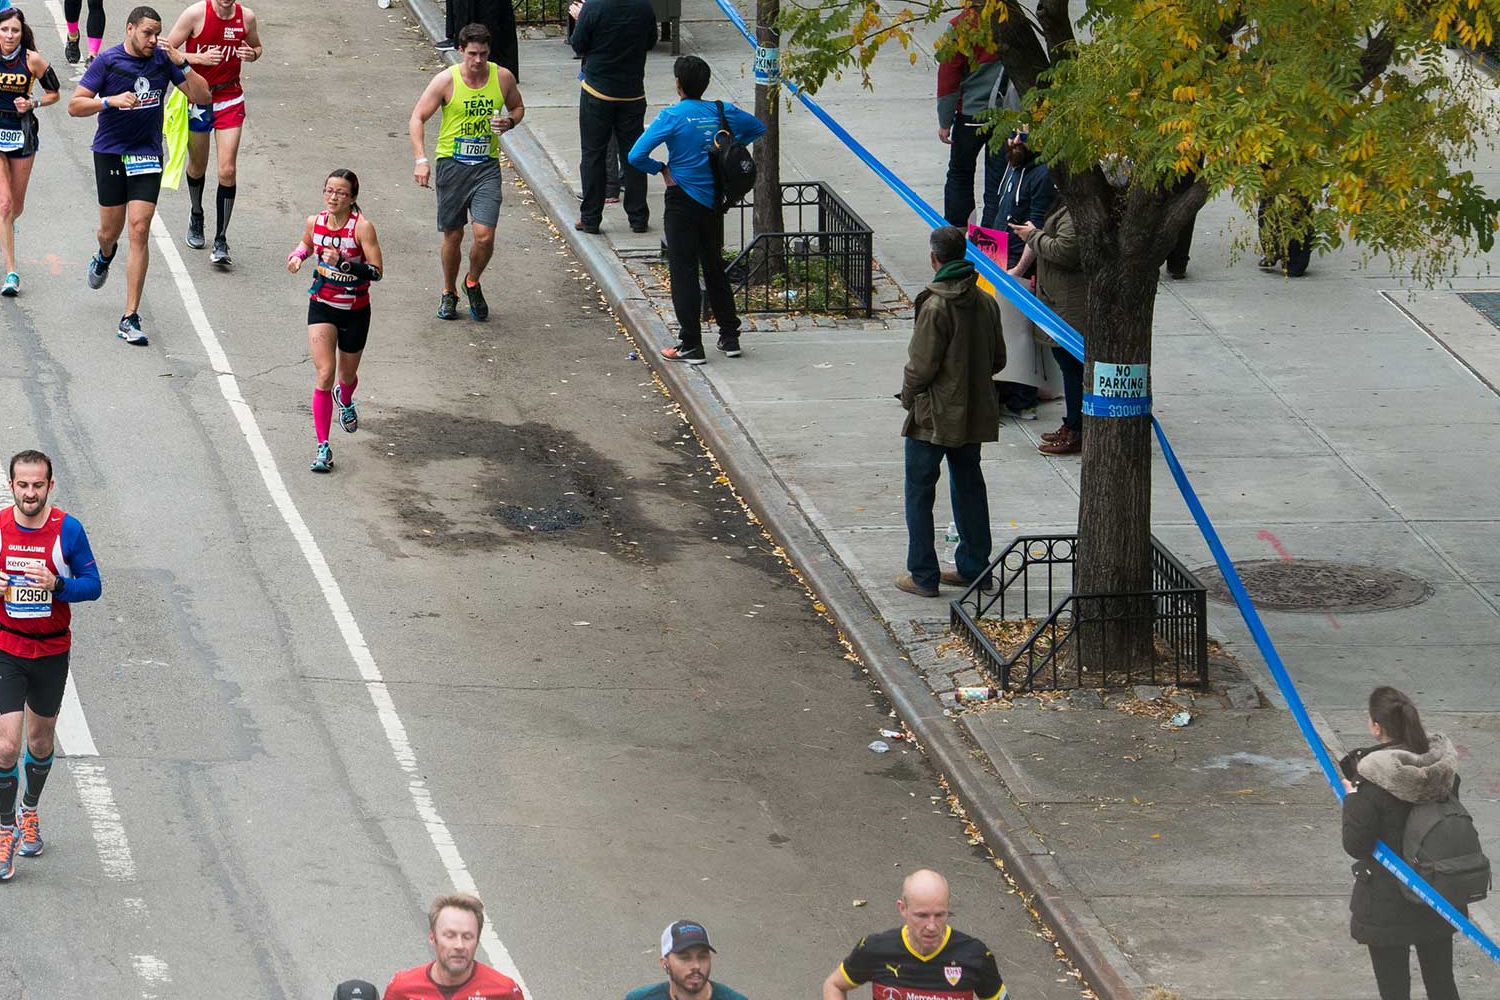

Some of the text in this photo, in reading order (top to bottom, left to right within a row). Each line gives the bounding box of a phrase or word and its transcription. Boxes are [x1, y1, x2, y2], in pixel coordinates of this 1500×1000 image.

[463, 99, 494, 110] TEAM
[468, 108, 493, 118] KIDS
[466, 144, 487, 155] 17817
[1115, 365, 1131, 377] NO
[1099, 376, 1143, 390] PARKING
[1100, 389, 1141, 398] SUNDAY
[8, 544, 46, 553] GUILLAUME
[16, 588, 48, 602] 12950
